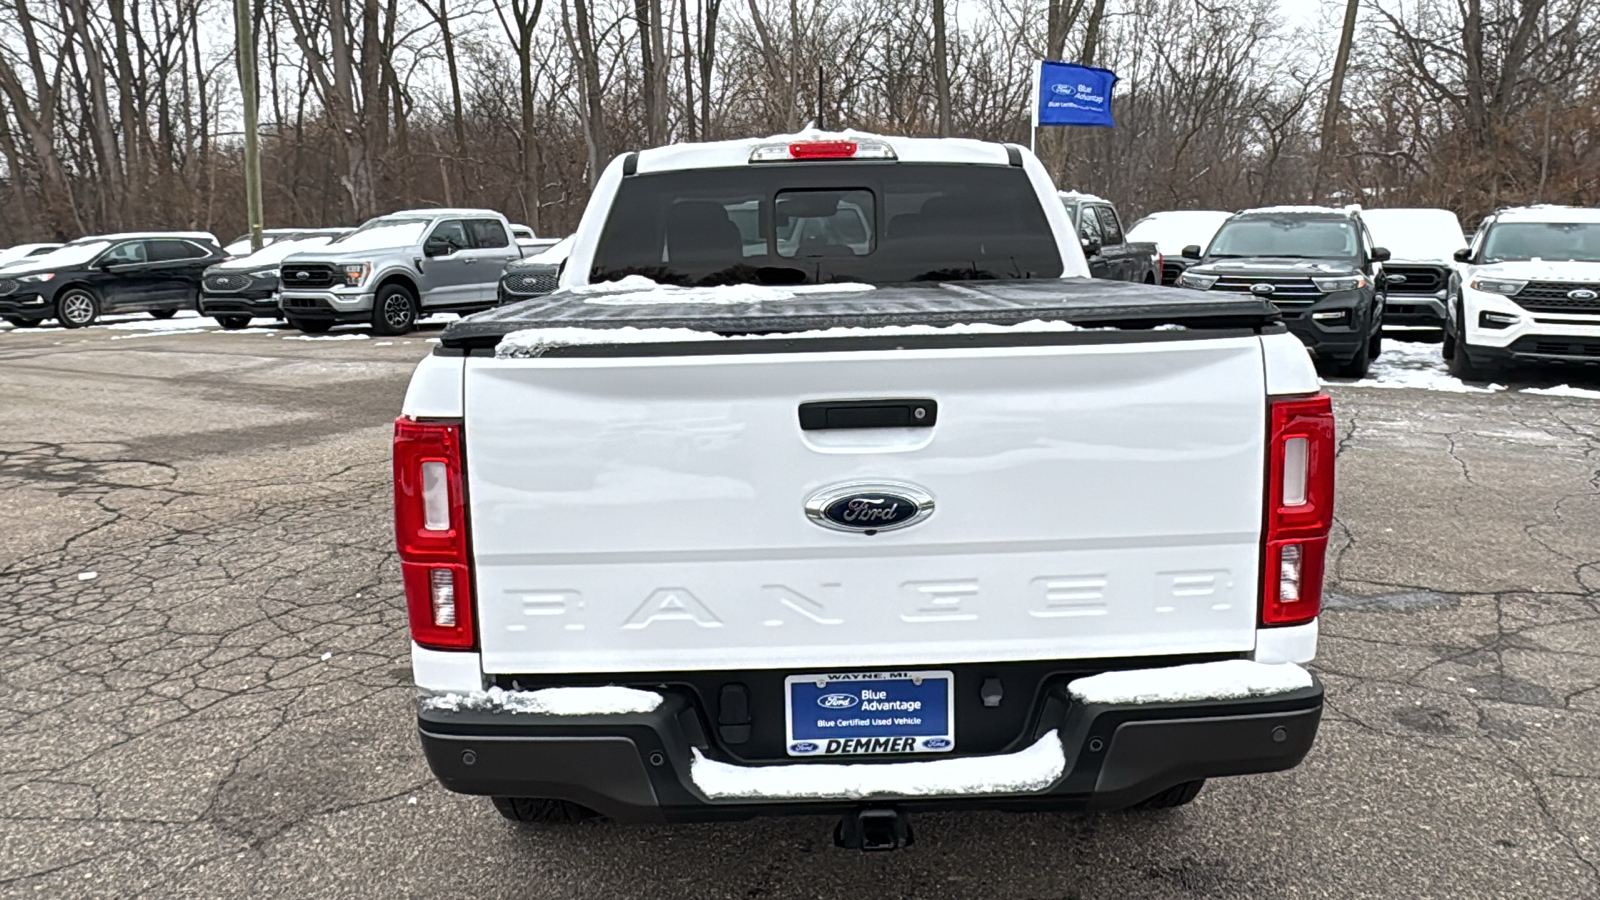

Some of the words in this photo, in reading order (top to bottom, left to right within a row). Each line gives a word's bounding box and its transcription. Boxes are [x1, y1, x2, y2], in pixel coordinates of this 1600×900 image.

[1077, 84, 1092, 93] Blue
[843, 498, 898, 521] Ford
[502, 568, 1233, 631] RANGER
[861, 690, 887, 700] Blue
[825, 696, 851, 707] Ford
[861, 700, 922, 712] Advantage
[817, 719, 836, 728] Blue
[836, 718, 870, 727] Certified
[872, 717, 892, 726] Used
[893, 717, 922, 725] Vehicle
[795, 743, 814, 751] Ford
[825, 737, 917, 754] DEMMER
[927, 740, 946, 748] Ford
